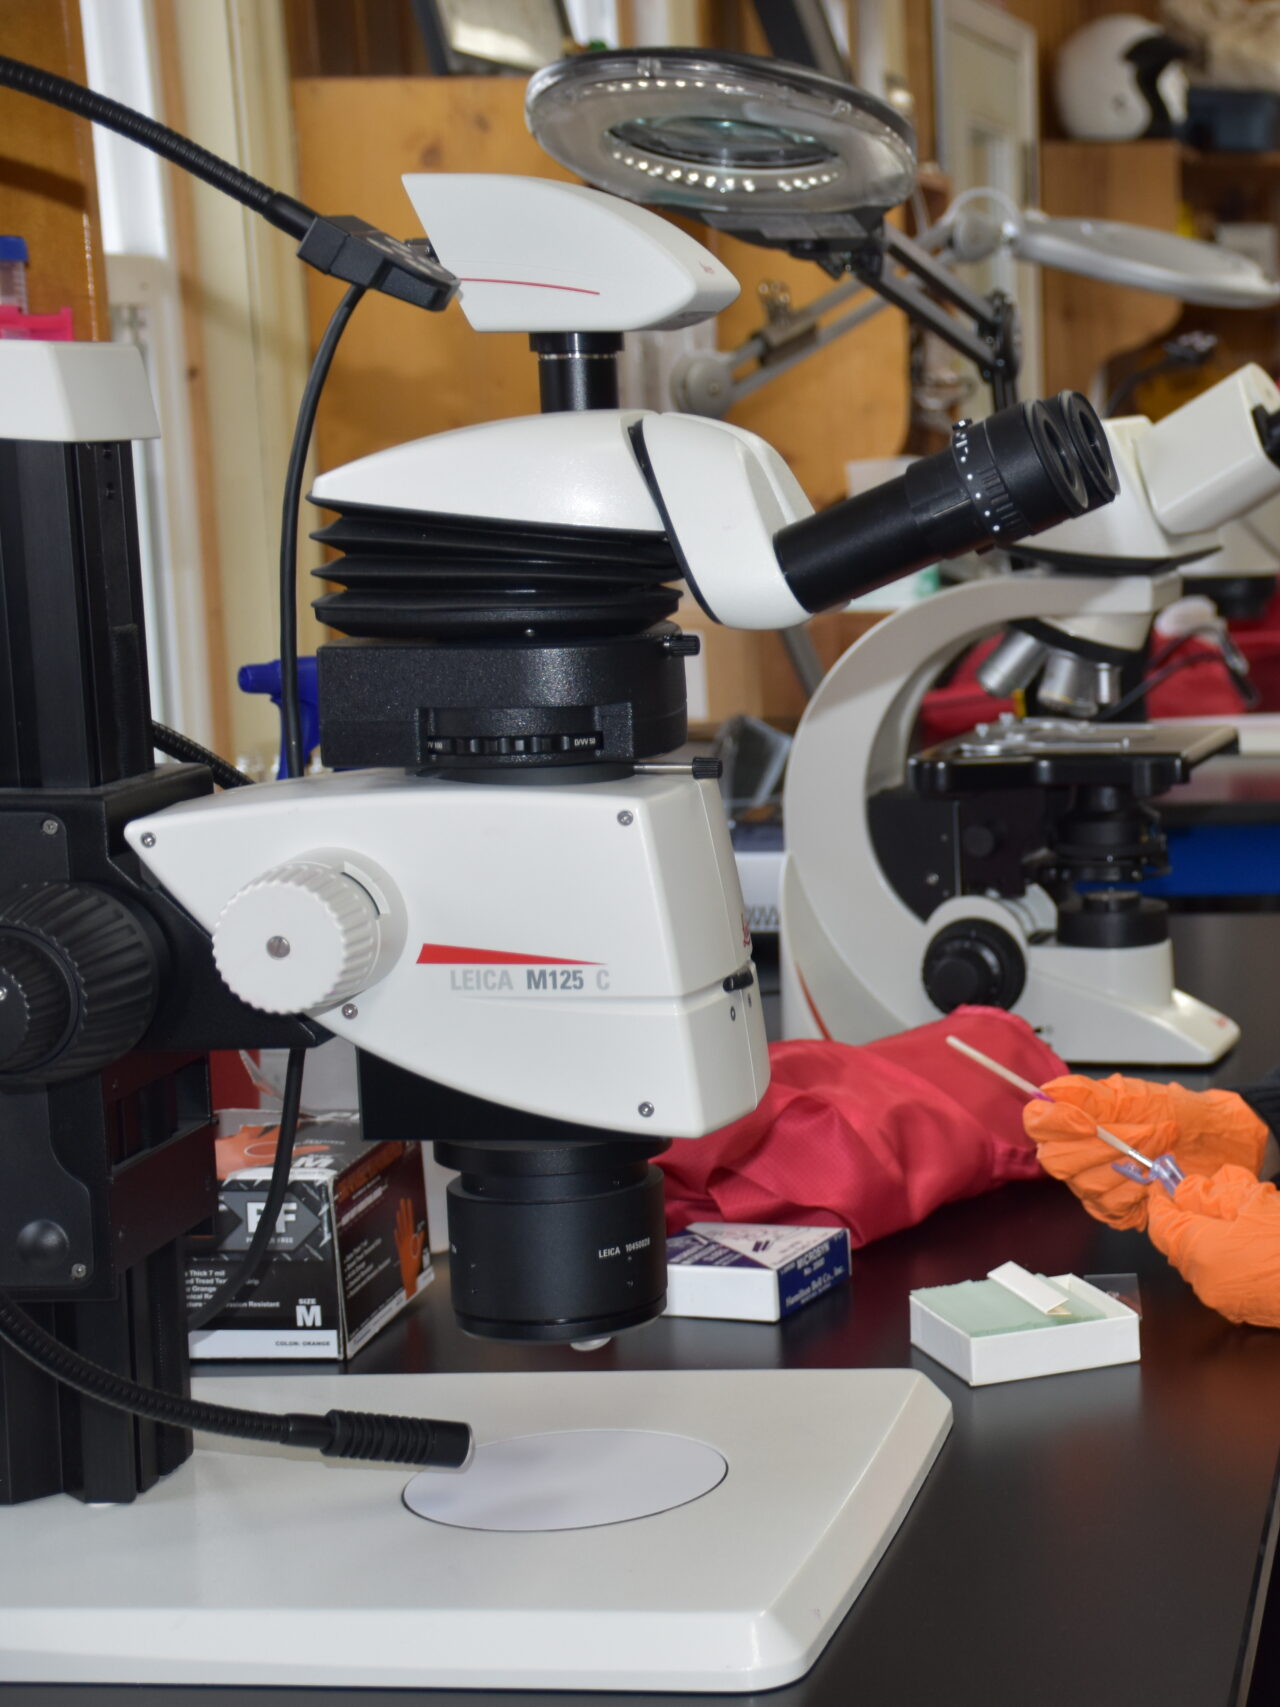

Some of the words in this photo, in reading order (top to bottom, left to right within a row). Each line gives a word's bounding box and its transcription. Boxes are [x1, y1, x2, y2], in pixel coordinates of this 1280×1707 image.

[450, 969, 514, 991] LEICA
[526, 969, 584, 991] M125
[595, 969, 611, 991] C
[598, 1246, 621, 1259] LEICA
[295, 1304, 322, 1328] M
